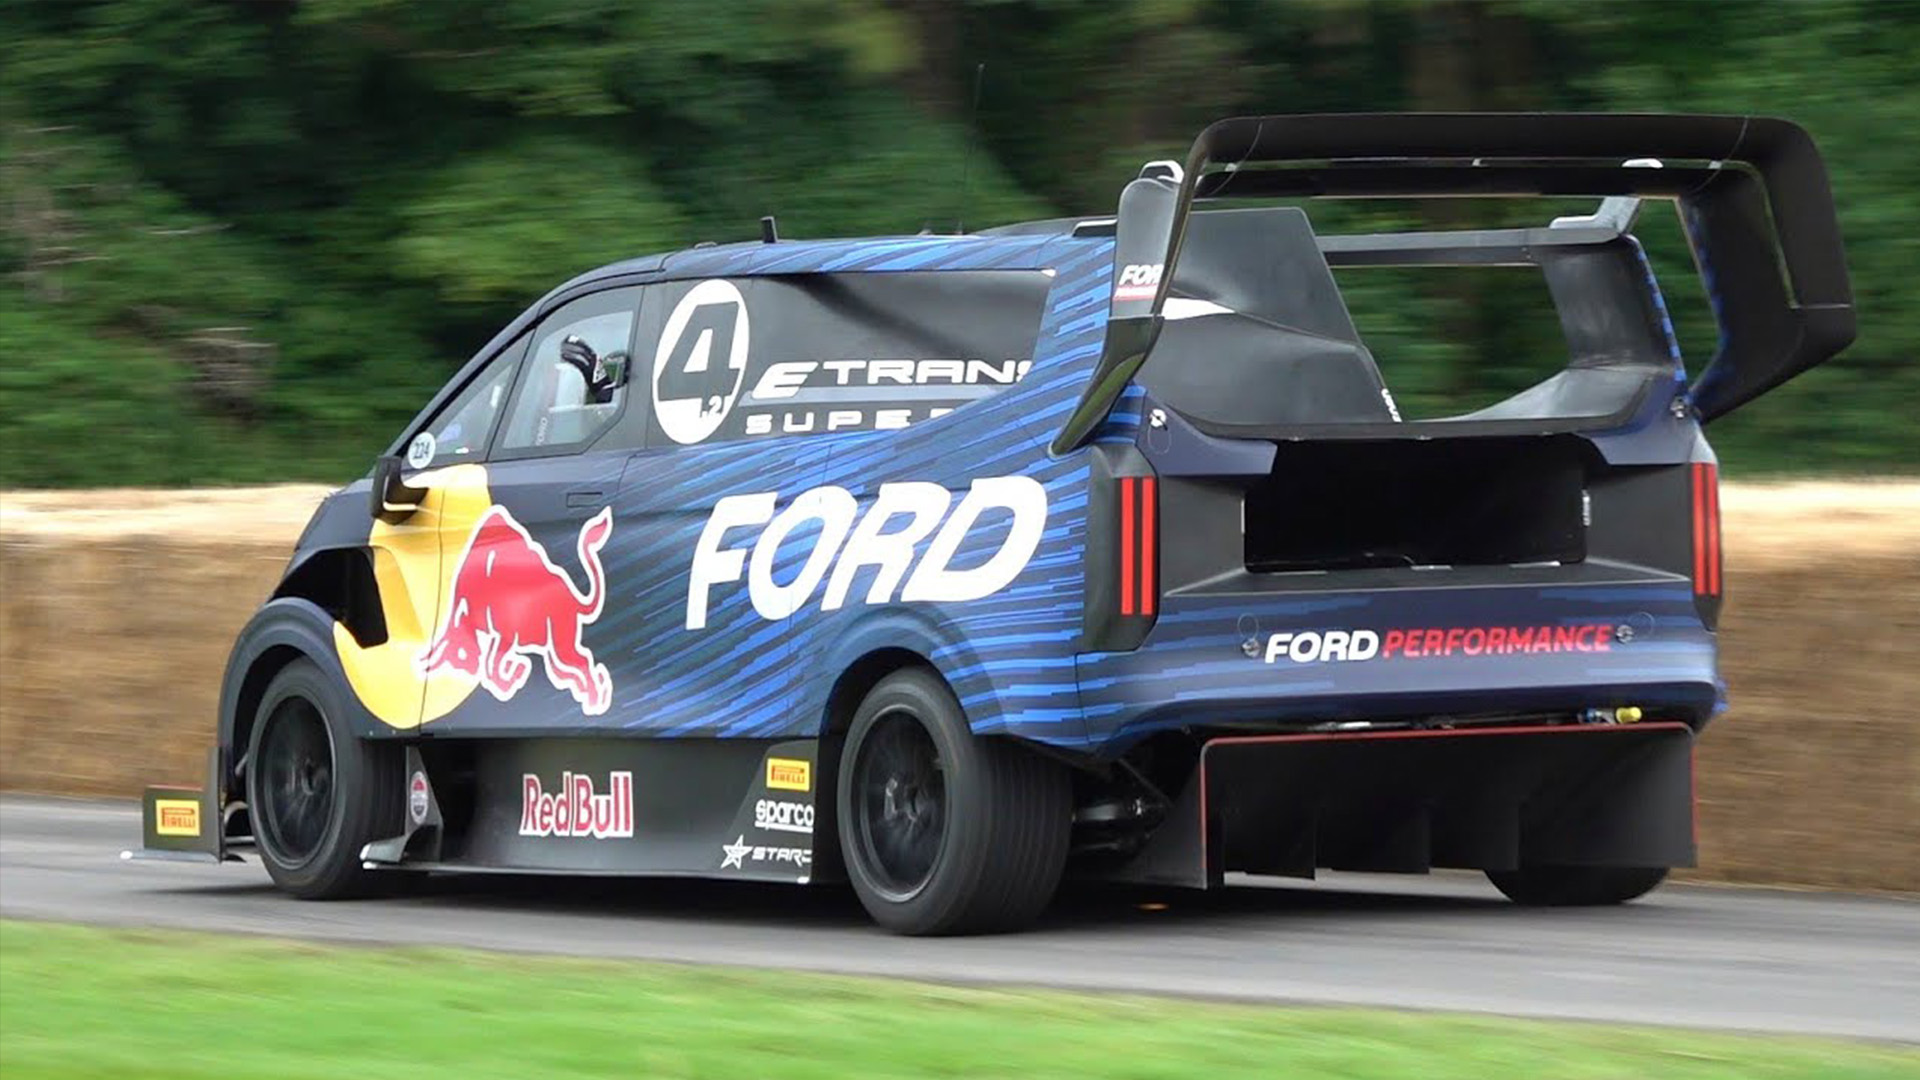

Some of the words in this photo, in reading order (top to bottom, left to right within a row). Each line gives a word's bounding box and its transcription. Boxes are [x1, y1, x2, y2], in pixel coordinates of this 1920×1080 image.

[745, 408, 955, 435] SUPE
[686, 475, 1048, 630] FORD
[1265, 630, 1379, 663] FORD
[1382, 625, 1613, 659] PERFORMANCE
[770, 765, 806, 784] PIRELLI
[755, 799, 815, 831] sparco
